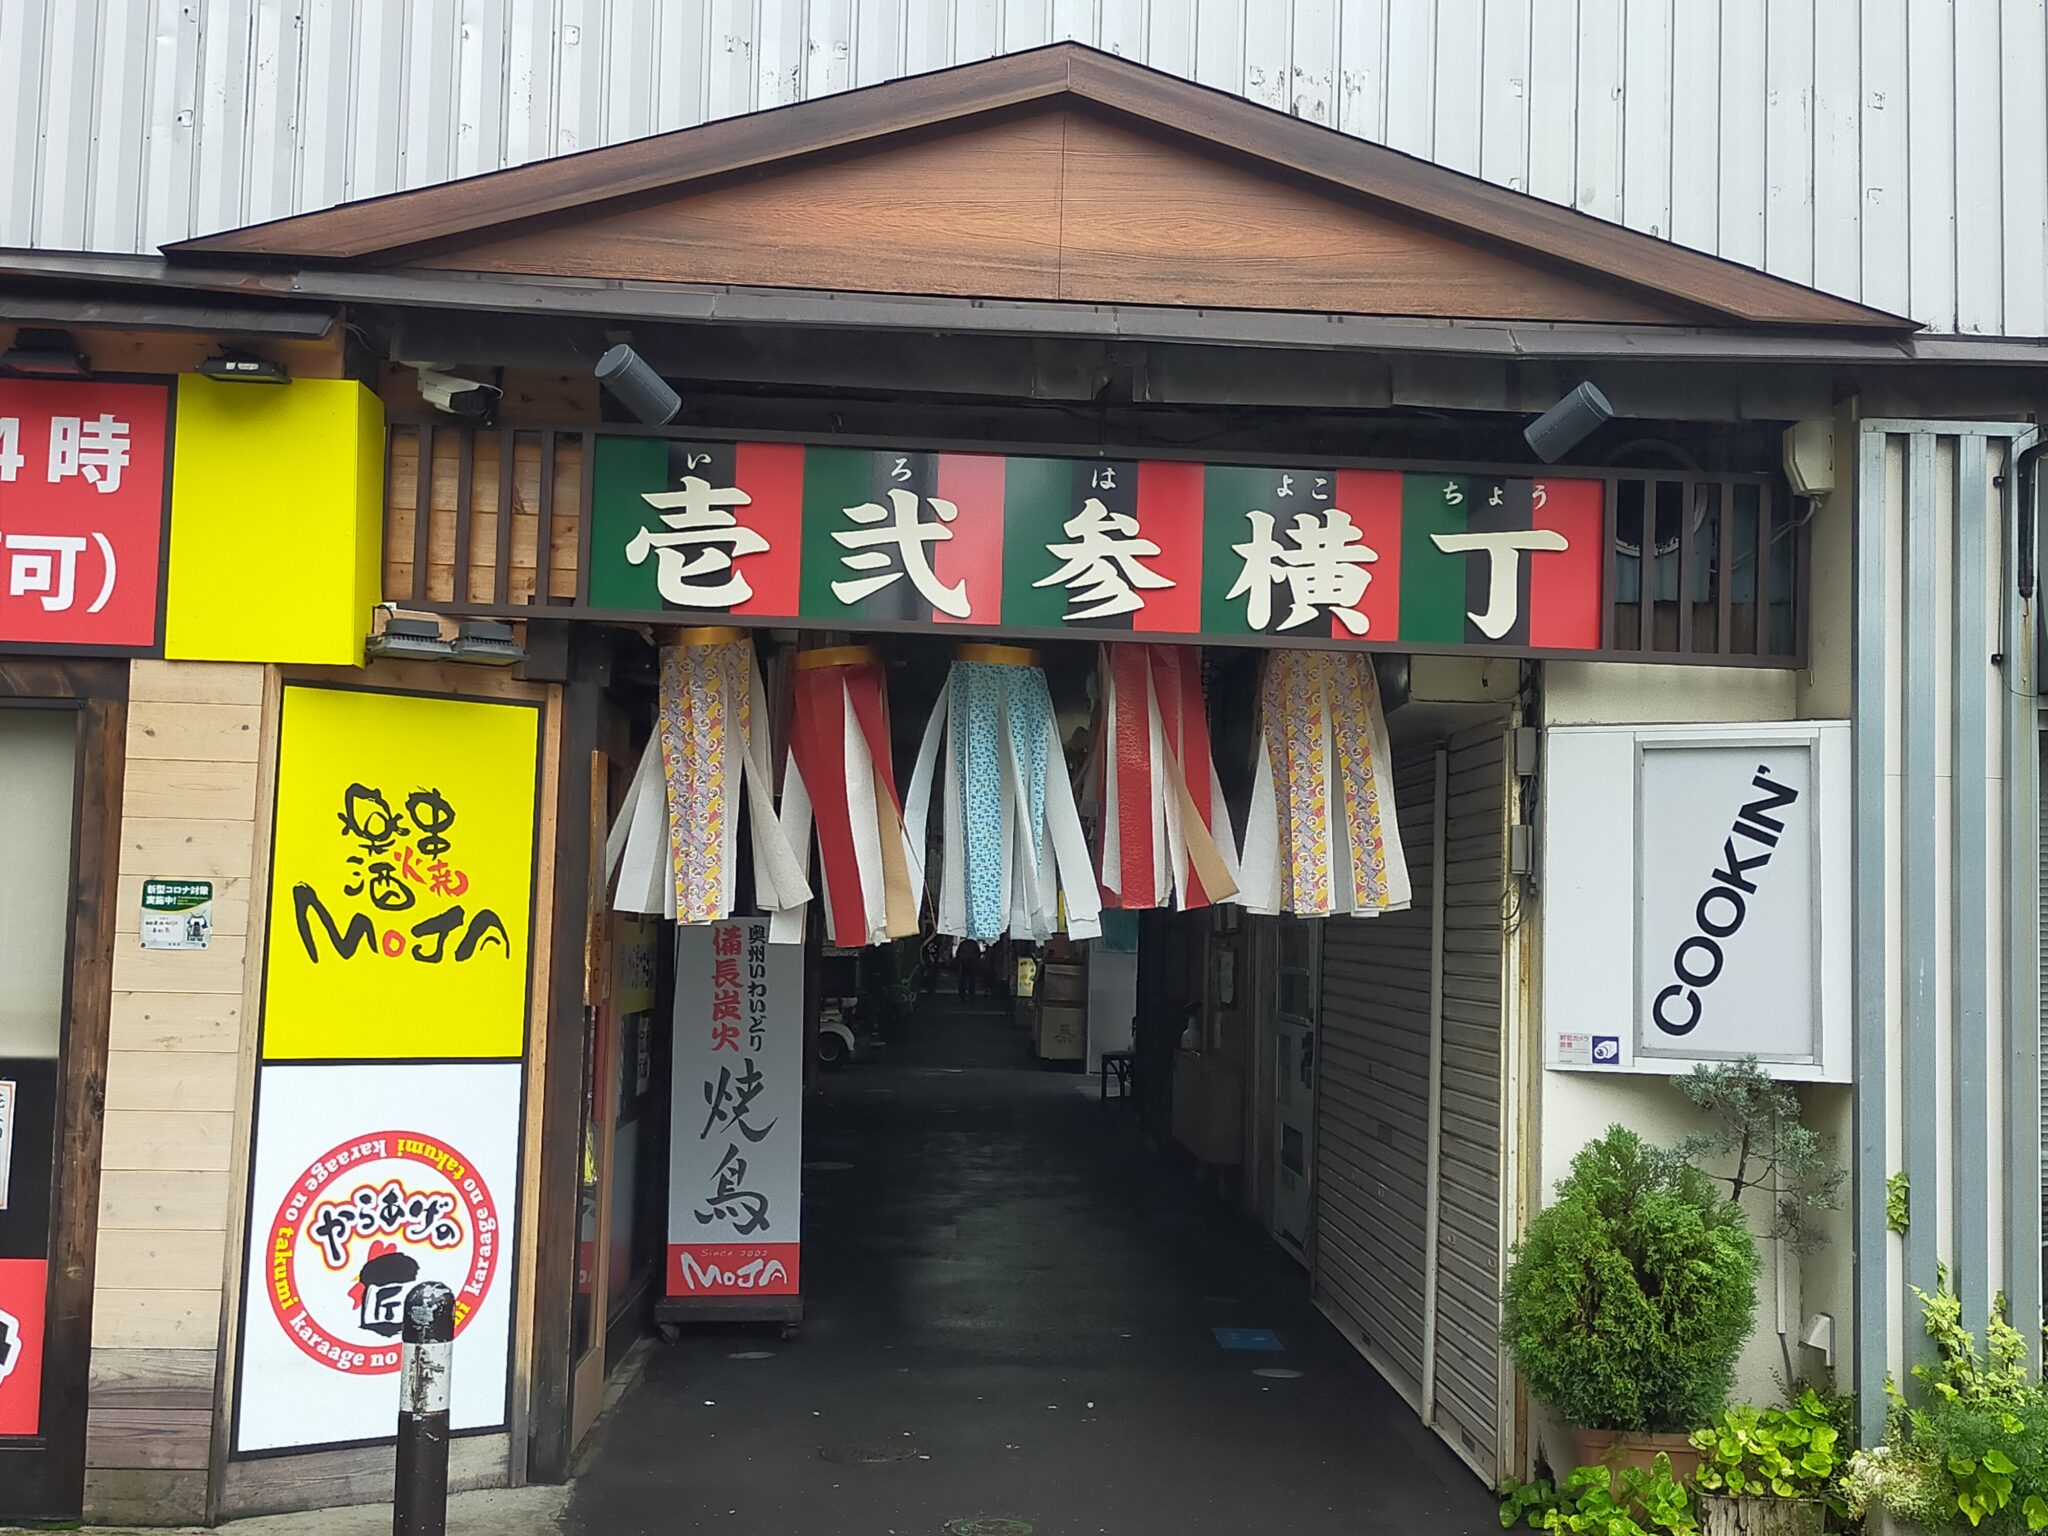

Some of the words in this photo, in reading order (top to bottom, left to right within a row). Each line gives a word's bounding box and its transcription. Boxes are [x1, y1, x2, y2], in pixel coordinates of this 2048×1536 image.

[687, 453, 711, 469] い
[891, 457, 912, 481] ろ
[1091, 467, 1116, 490] は
[711, 925, 744, 1053] 備長炭火
[747, 924, 768, 1052] 奥州いわいどり
[305, 1139, 386, 1191] karaage
[398, 1139, 466, 1181] takumi
[694, 1057, 778, 1236] 焼鳥
[285, 1191, 308, 1221] no
[463, 1179, 489, 1211] no
[273, 1226, 299, 1311] takumi
[463, 1209, 497, 1296] karaage
[289, 1310, 365, 1370] karaage
[370, 1352, 398, 1366] no
